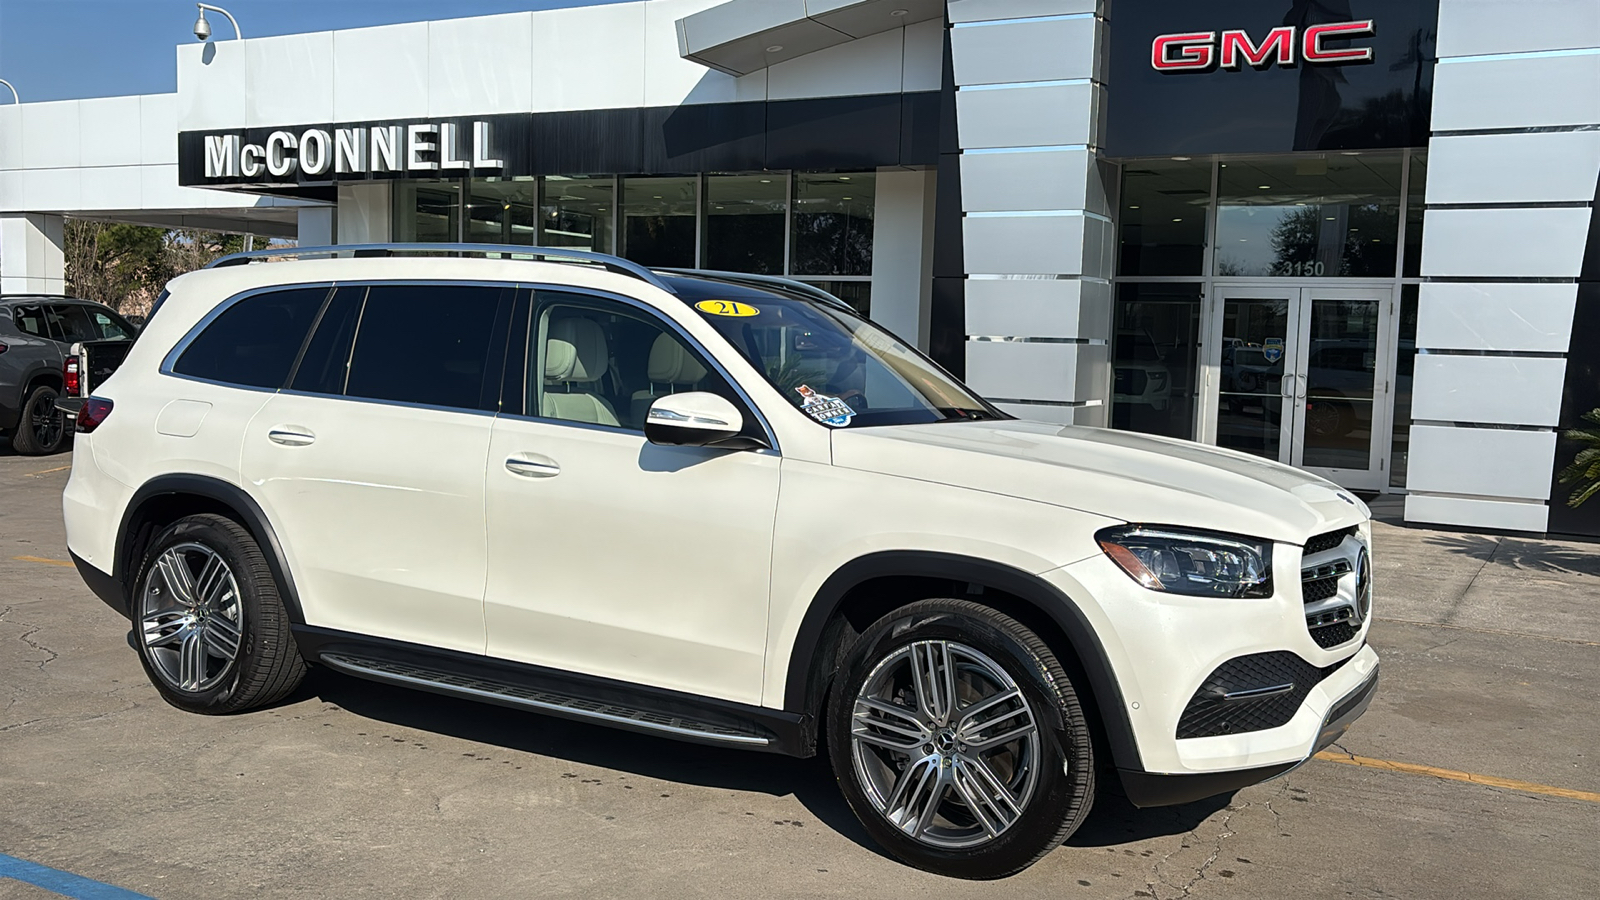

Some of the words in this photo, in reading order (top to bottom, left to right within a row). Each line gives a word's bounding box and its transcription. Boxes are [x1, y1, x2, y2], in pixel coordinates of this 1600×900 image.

[1151, 19, 1374, 71] GMC
[204, 121, 504, 178] McCONNELL
[1282, 260, 1325, 276] 3150
[714, 301, 742, 315] 21
